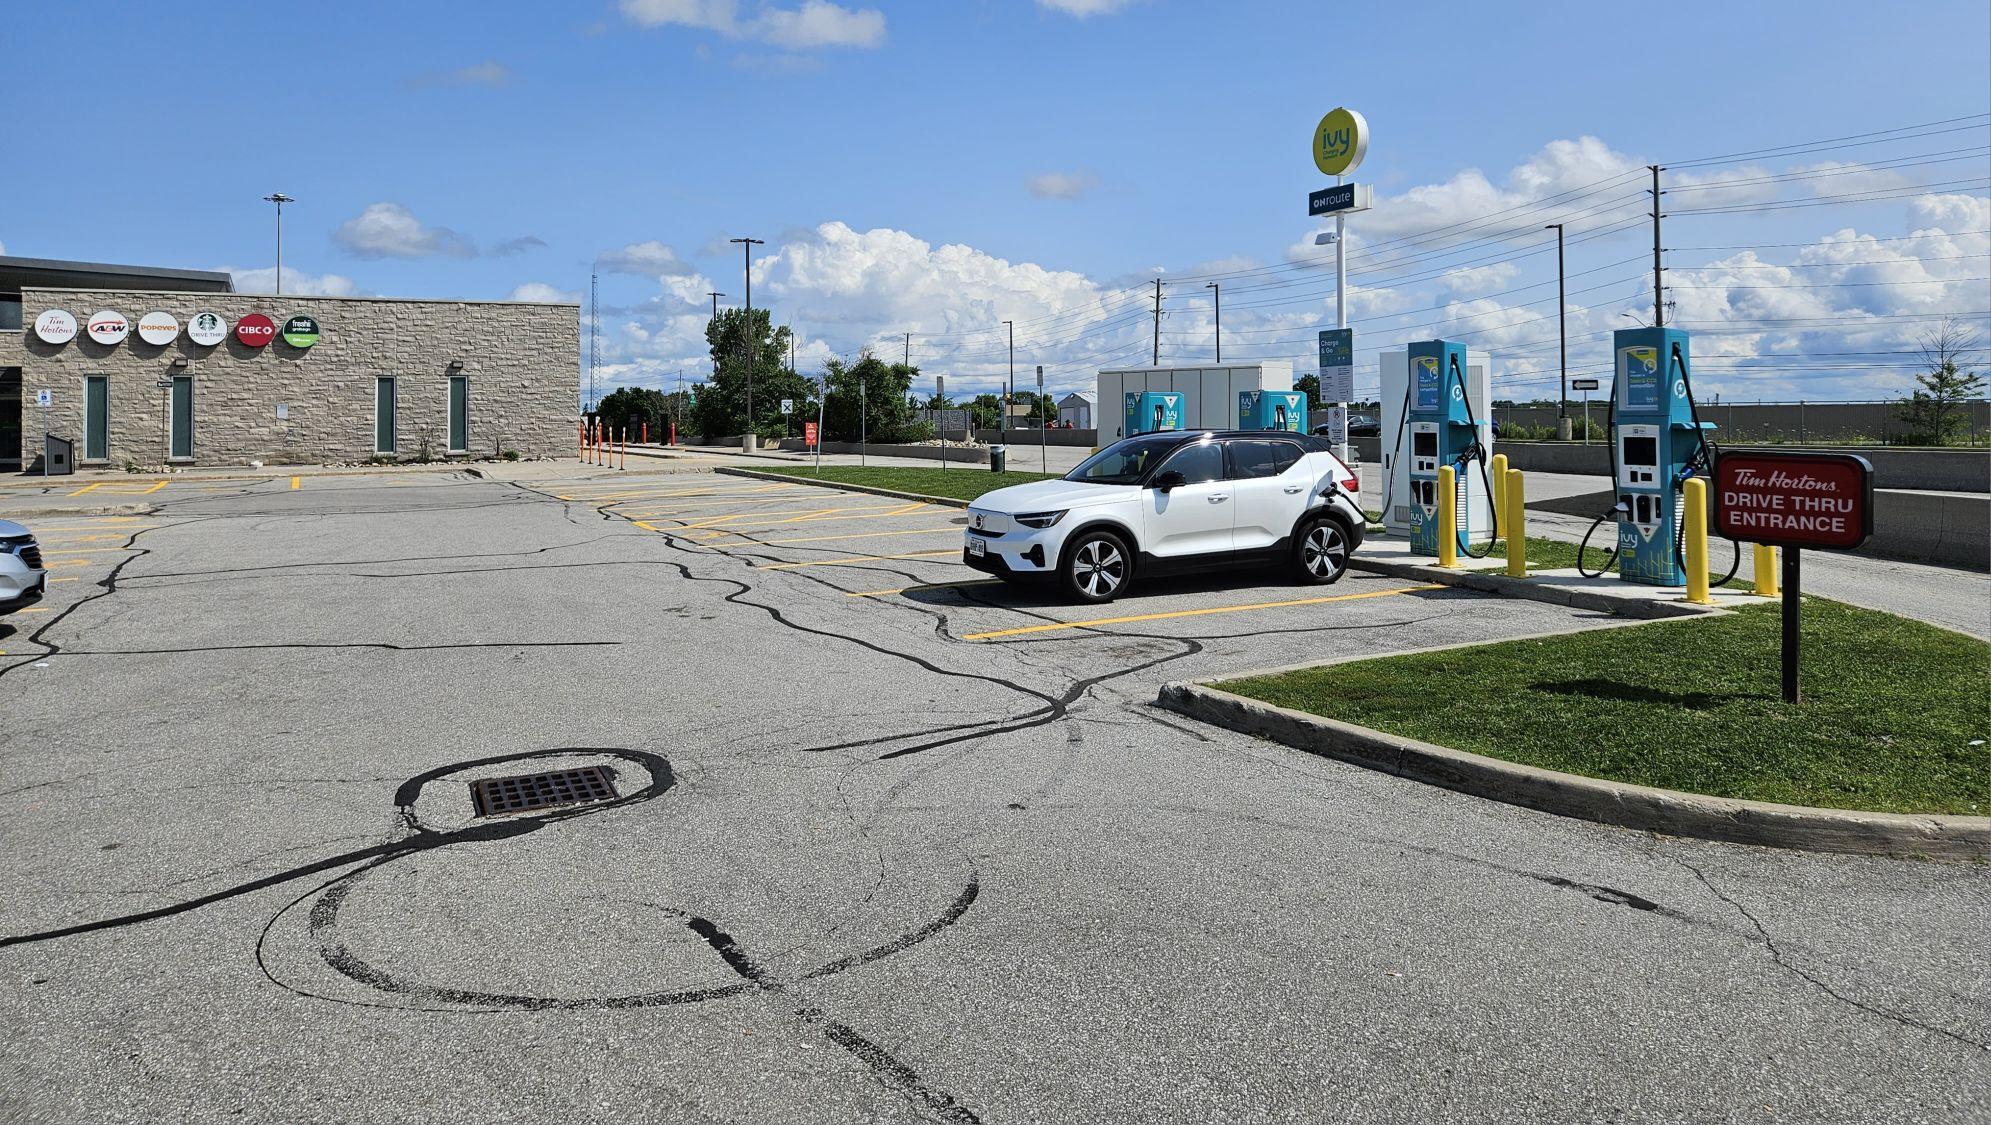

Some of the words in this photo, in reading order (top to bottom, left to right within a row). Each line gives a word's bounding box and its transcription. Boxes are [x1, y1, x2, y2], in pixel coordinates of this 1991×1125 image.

[1322, 127, 1350, 157] ivy
[49, 316, 65, 325] Tim
[40, 324, 73, 334] Hortons
[94, 325, 126, 333] A&W
[238, 326, 262, 334] CIBC
[1320, 340, 1339, 349] Charge
[1734, 469, 1764, 488] Tim
[1767, 470, 1837, 492] Hortons
[1724, 491, 1785, 510] DRIVE
[1791, 496, 1854, 513] THRU
[1410, 510, 1423, 526] ivy
[1729, 511, 1846, 533] ENTRANCE
[1620, 530, 1638, 548] ivy
